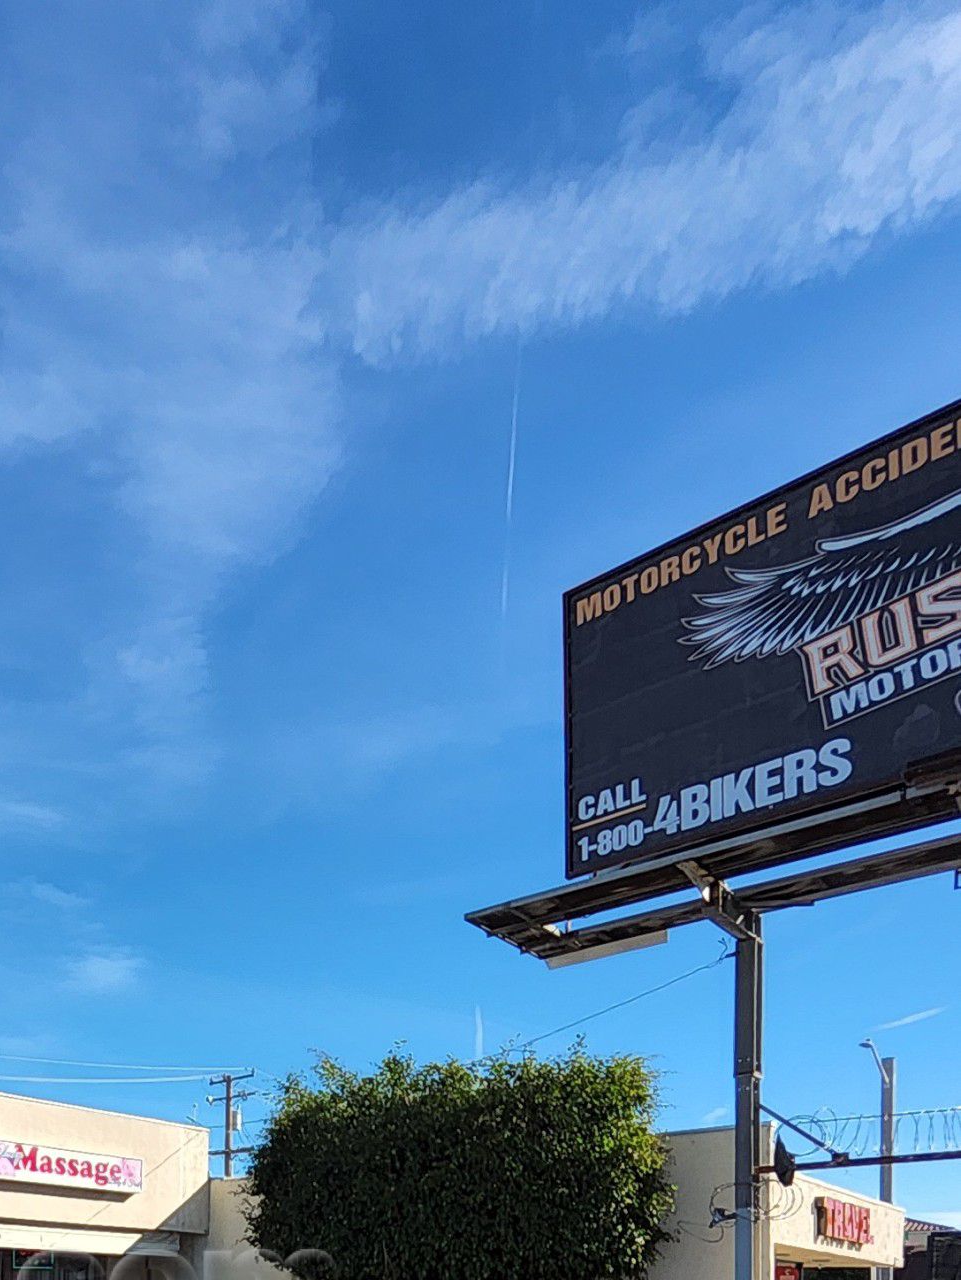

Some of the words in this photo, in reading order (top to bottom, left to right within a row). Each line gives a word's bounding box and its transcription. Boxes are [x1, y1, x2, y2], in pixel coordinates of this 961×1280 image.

[575, 502, 787, 627] MOTORCYCLE
[807, 418, 961, 519] ACCIDE
[577, 777, 647, 821] CALL
[15, 1142, 122, 1186] Massage
